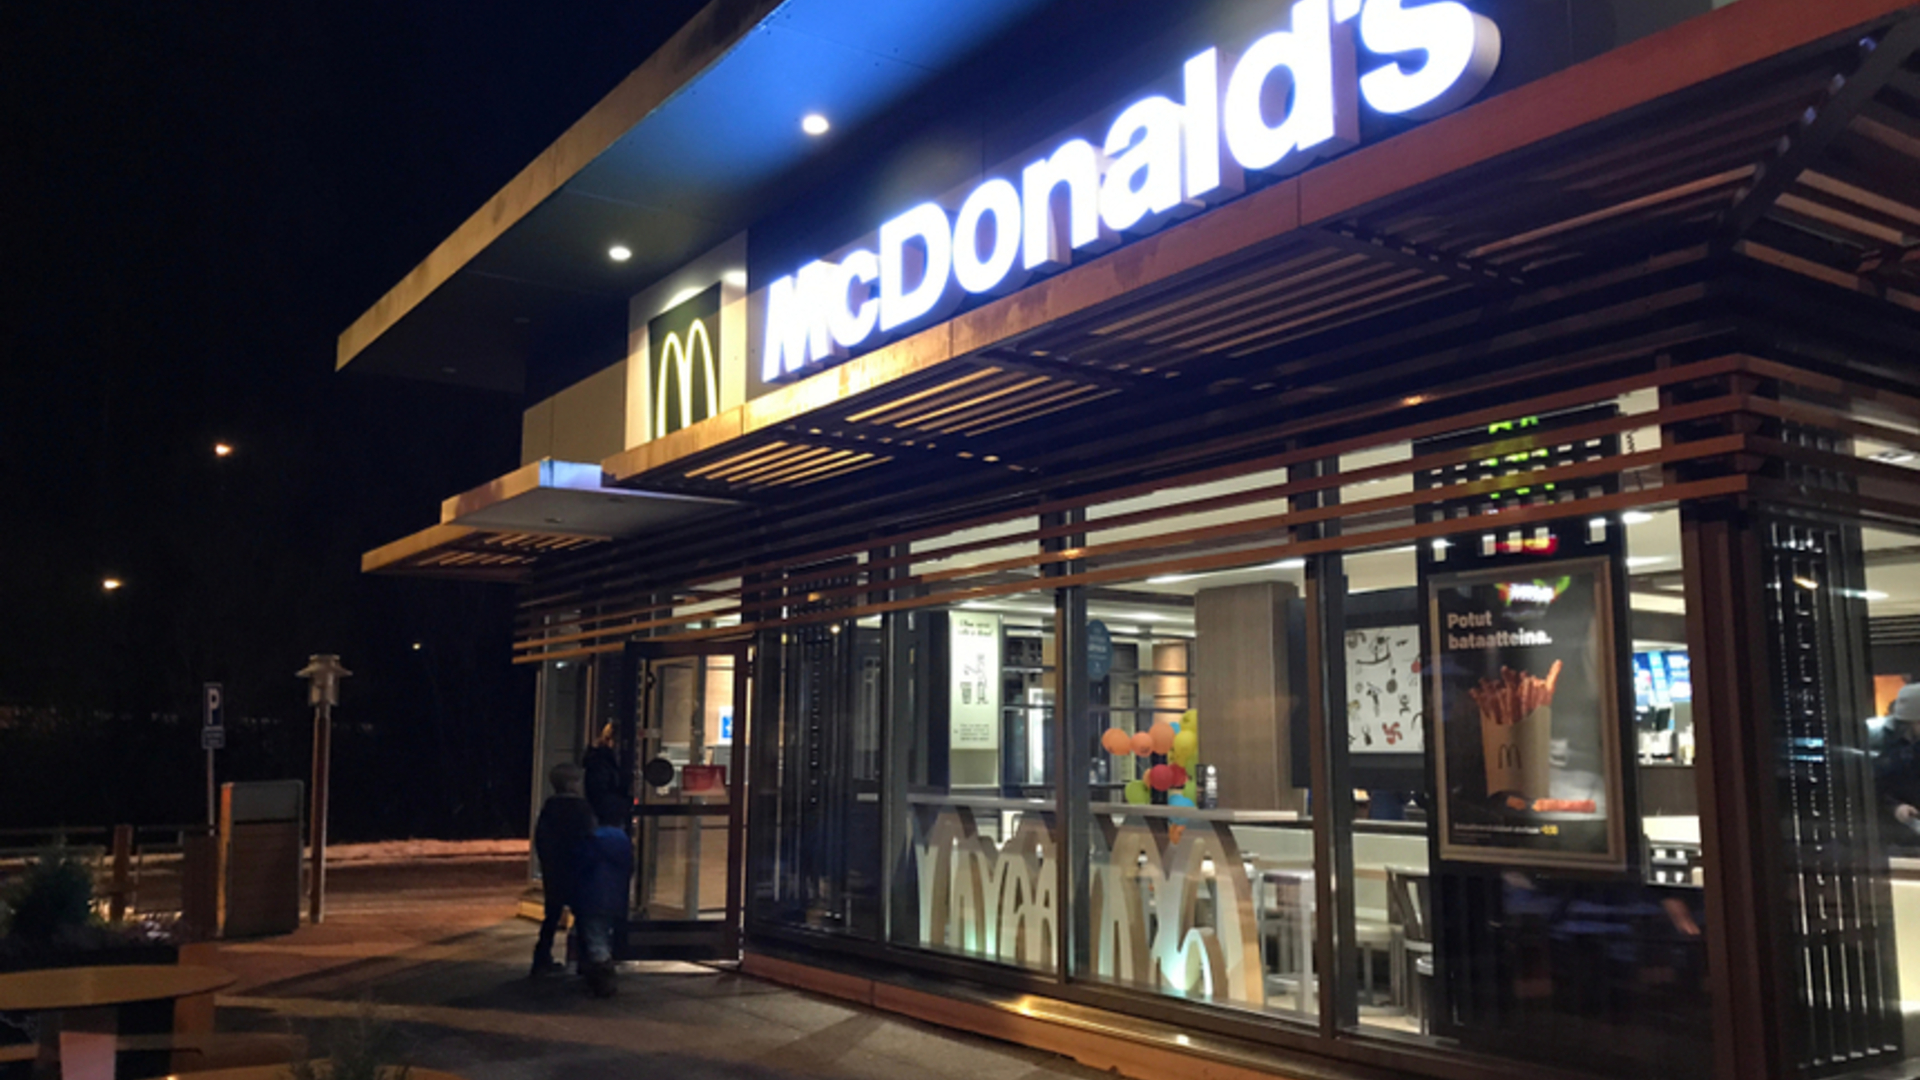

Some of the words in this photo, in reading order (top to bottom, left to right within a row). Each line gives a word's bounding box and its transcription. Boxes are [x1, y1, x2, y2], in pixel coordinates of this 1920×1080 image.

[761, 0, 1485, 383] McDonald's
[1447, 610, 1492, 629] Potut
[1448, 627, 1552, 649] bataatteina.
[207, 688, 220, 725] P
